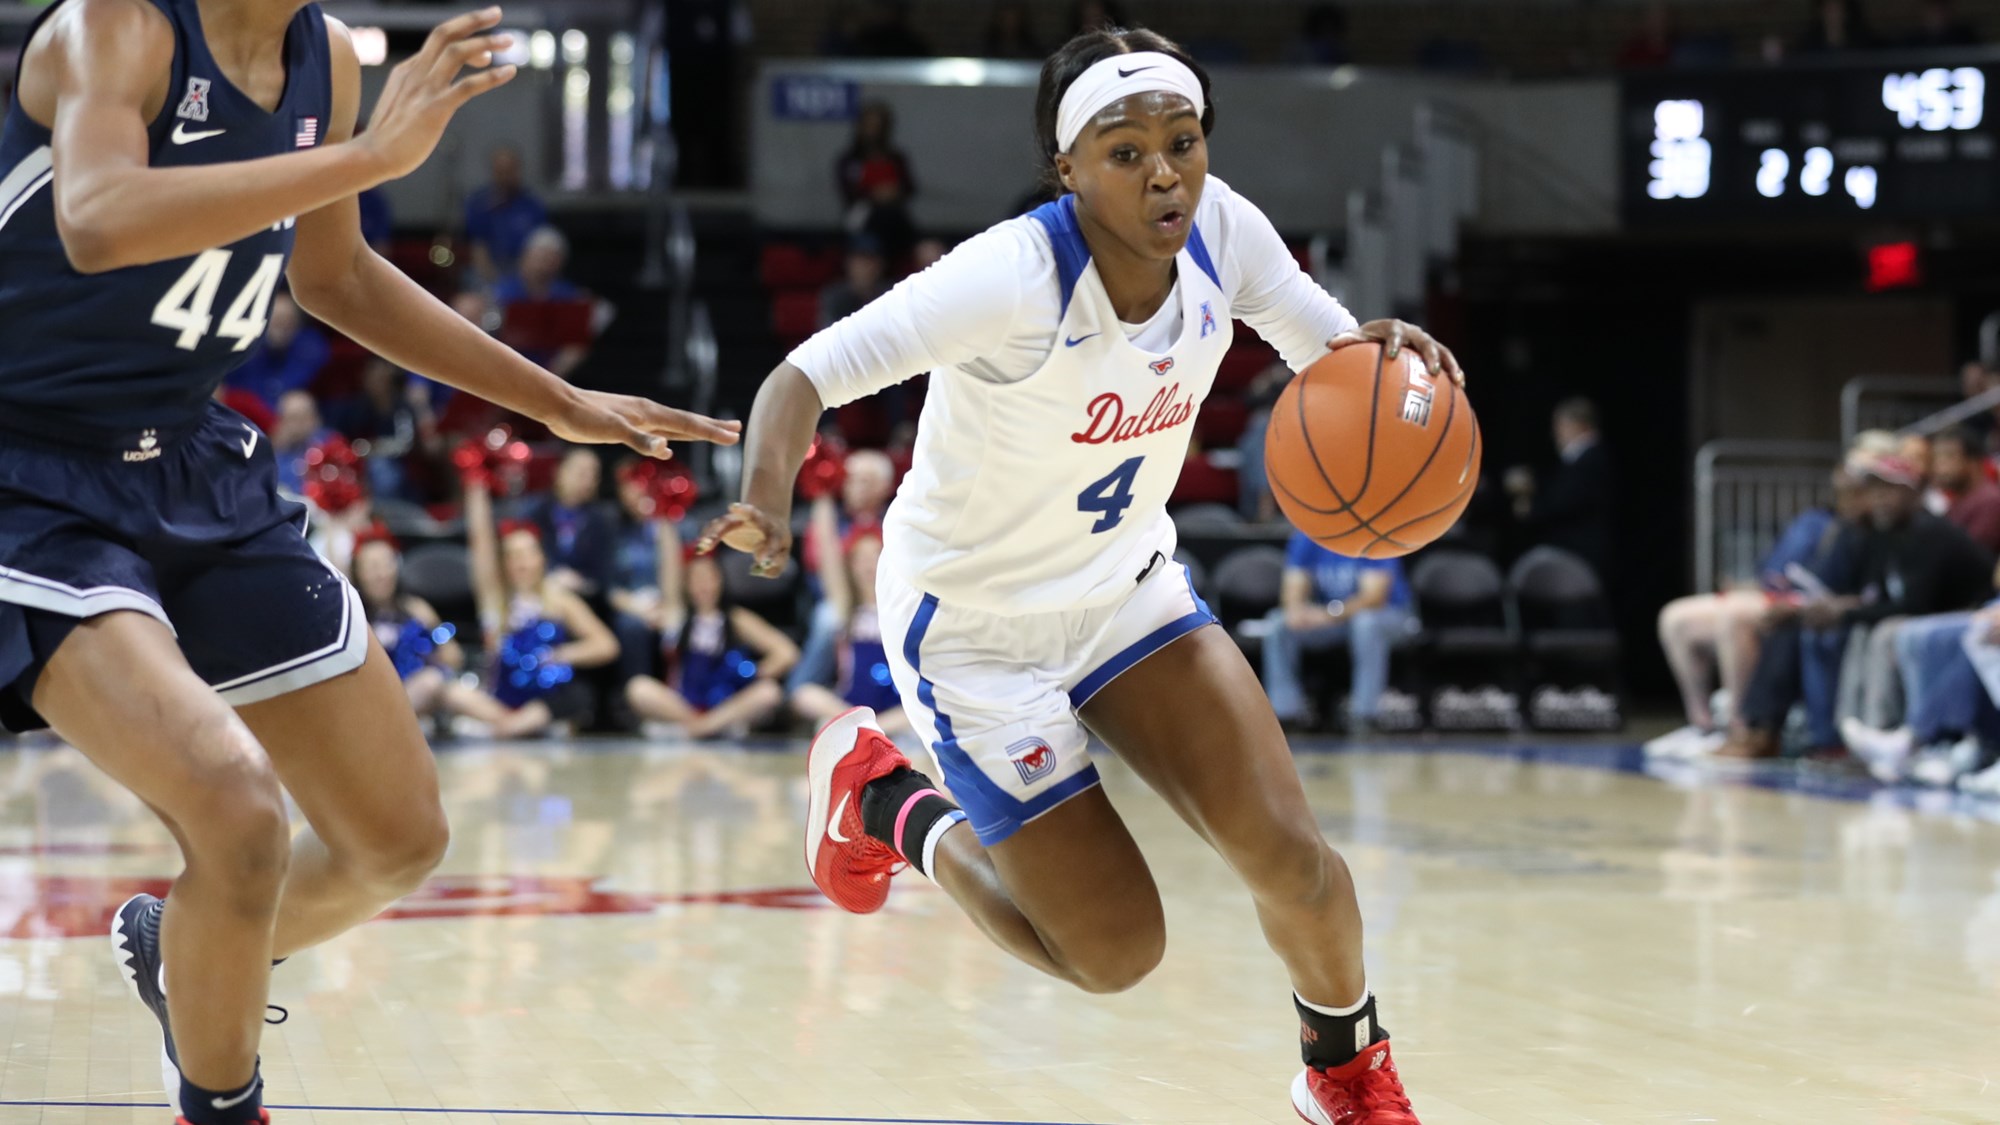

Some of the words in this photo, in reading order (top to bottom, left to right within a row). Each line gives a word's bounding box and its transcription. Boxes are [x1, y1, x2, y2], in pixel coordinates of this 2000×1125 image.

[151, 248, 284, 351] 44
[1071, 382, 1195, 444] Dallas
[1077, 455, 1146, 534] 4
